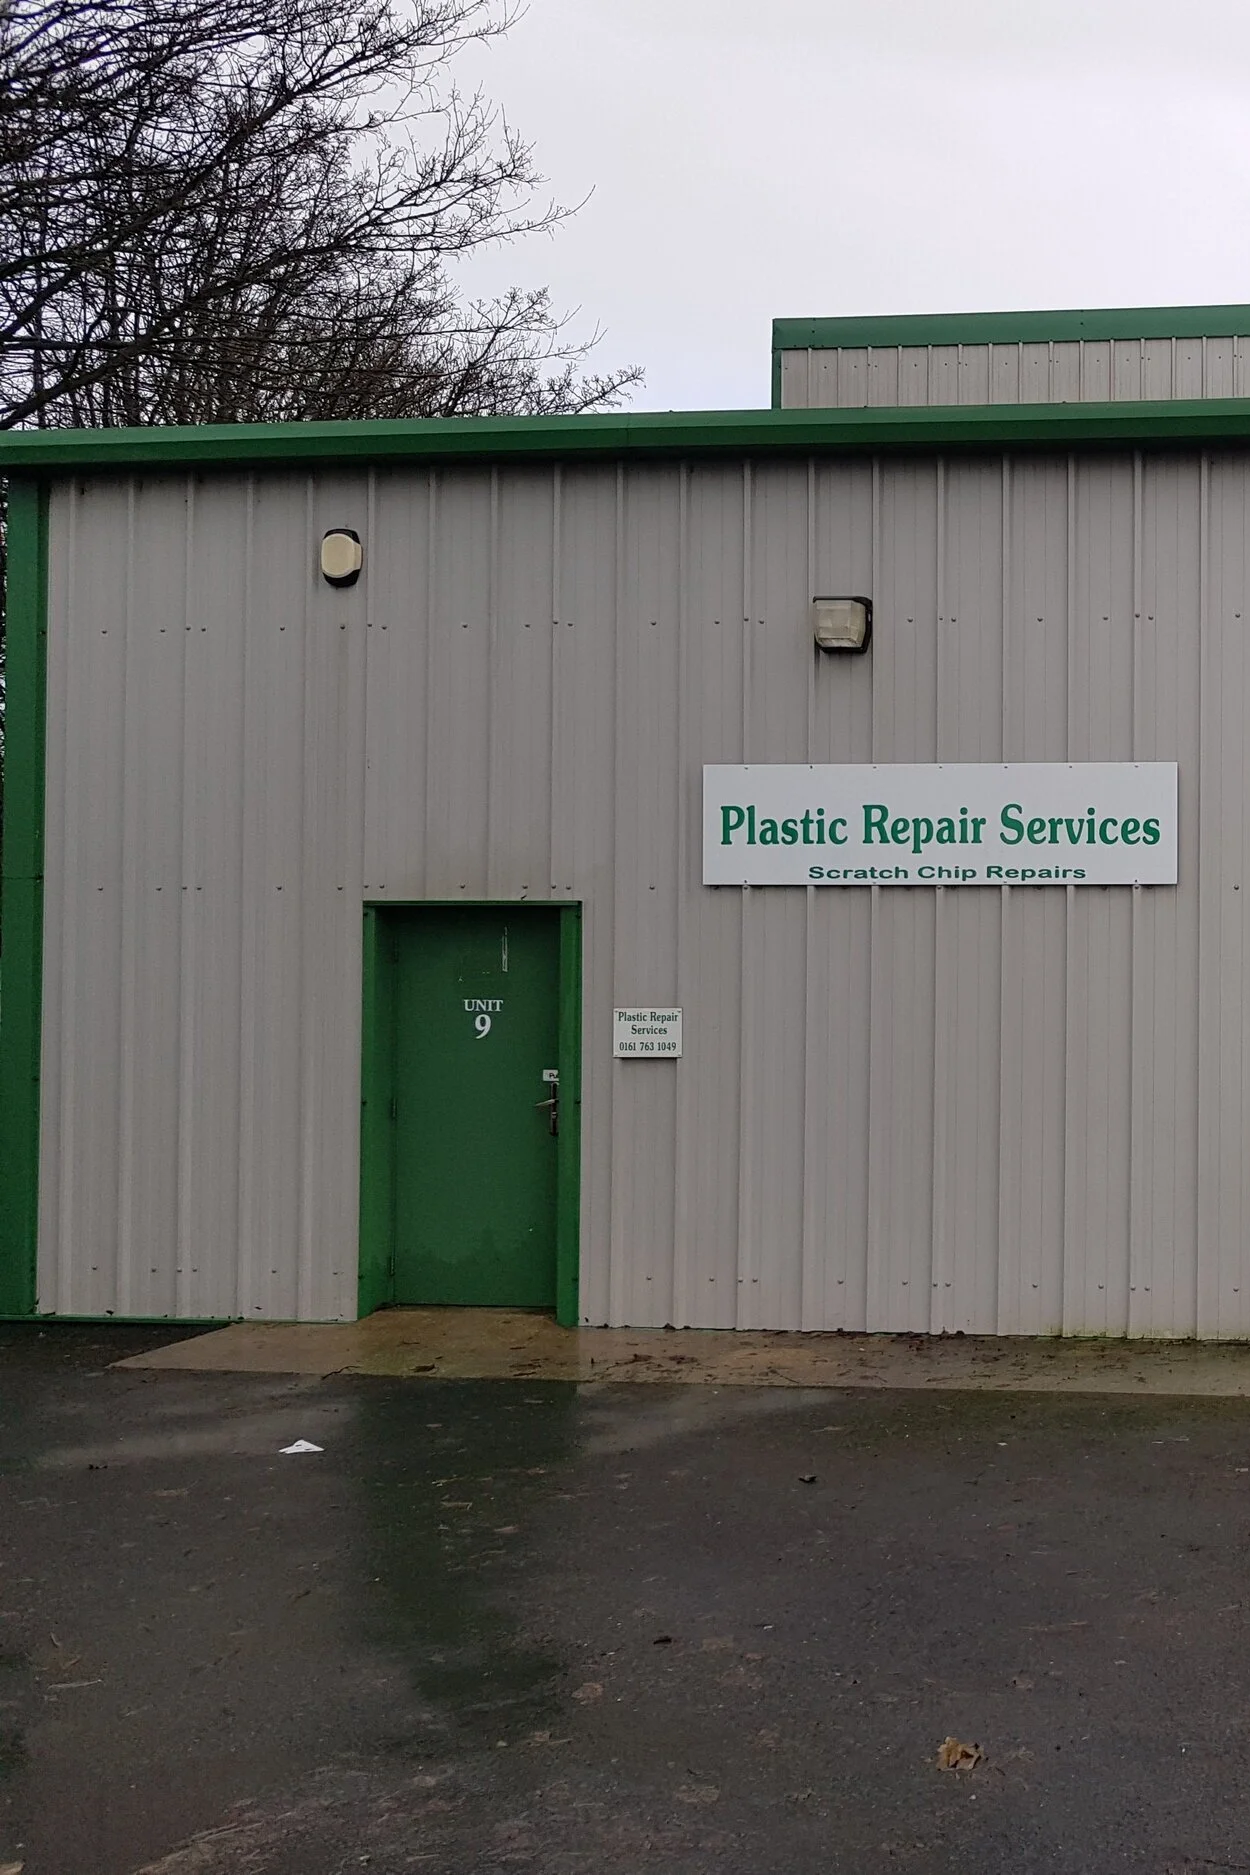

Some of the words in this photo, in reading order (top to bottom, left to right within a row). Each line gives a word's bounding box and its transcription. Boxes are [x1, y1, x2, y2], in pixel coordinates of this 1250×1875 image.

[720, 804, 848, 845] Plastic
[862, 804, 987, 854] Repair
[1000, 803, 1161, 846] Services
[808, 866, 909, 879] Scratch
[917, 866, 977, 881] Chip
[986, 865, 1086, 880] Repairs
[464, 999, 504, 1012] UNIT
[618, 1011, 647, 1022] Plastic
[650, 1011, 678, 1024] Repair
[474, 1013, 492, 1039] 9
[631, 1024, 668, 1035] Services
[619, 1041, 636, 1051] 0161
[639, 1041, 655, 1052] 763
[657, 1041, 677, 1051] 1049
